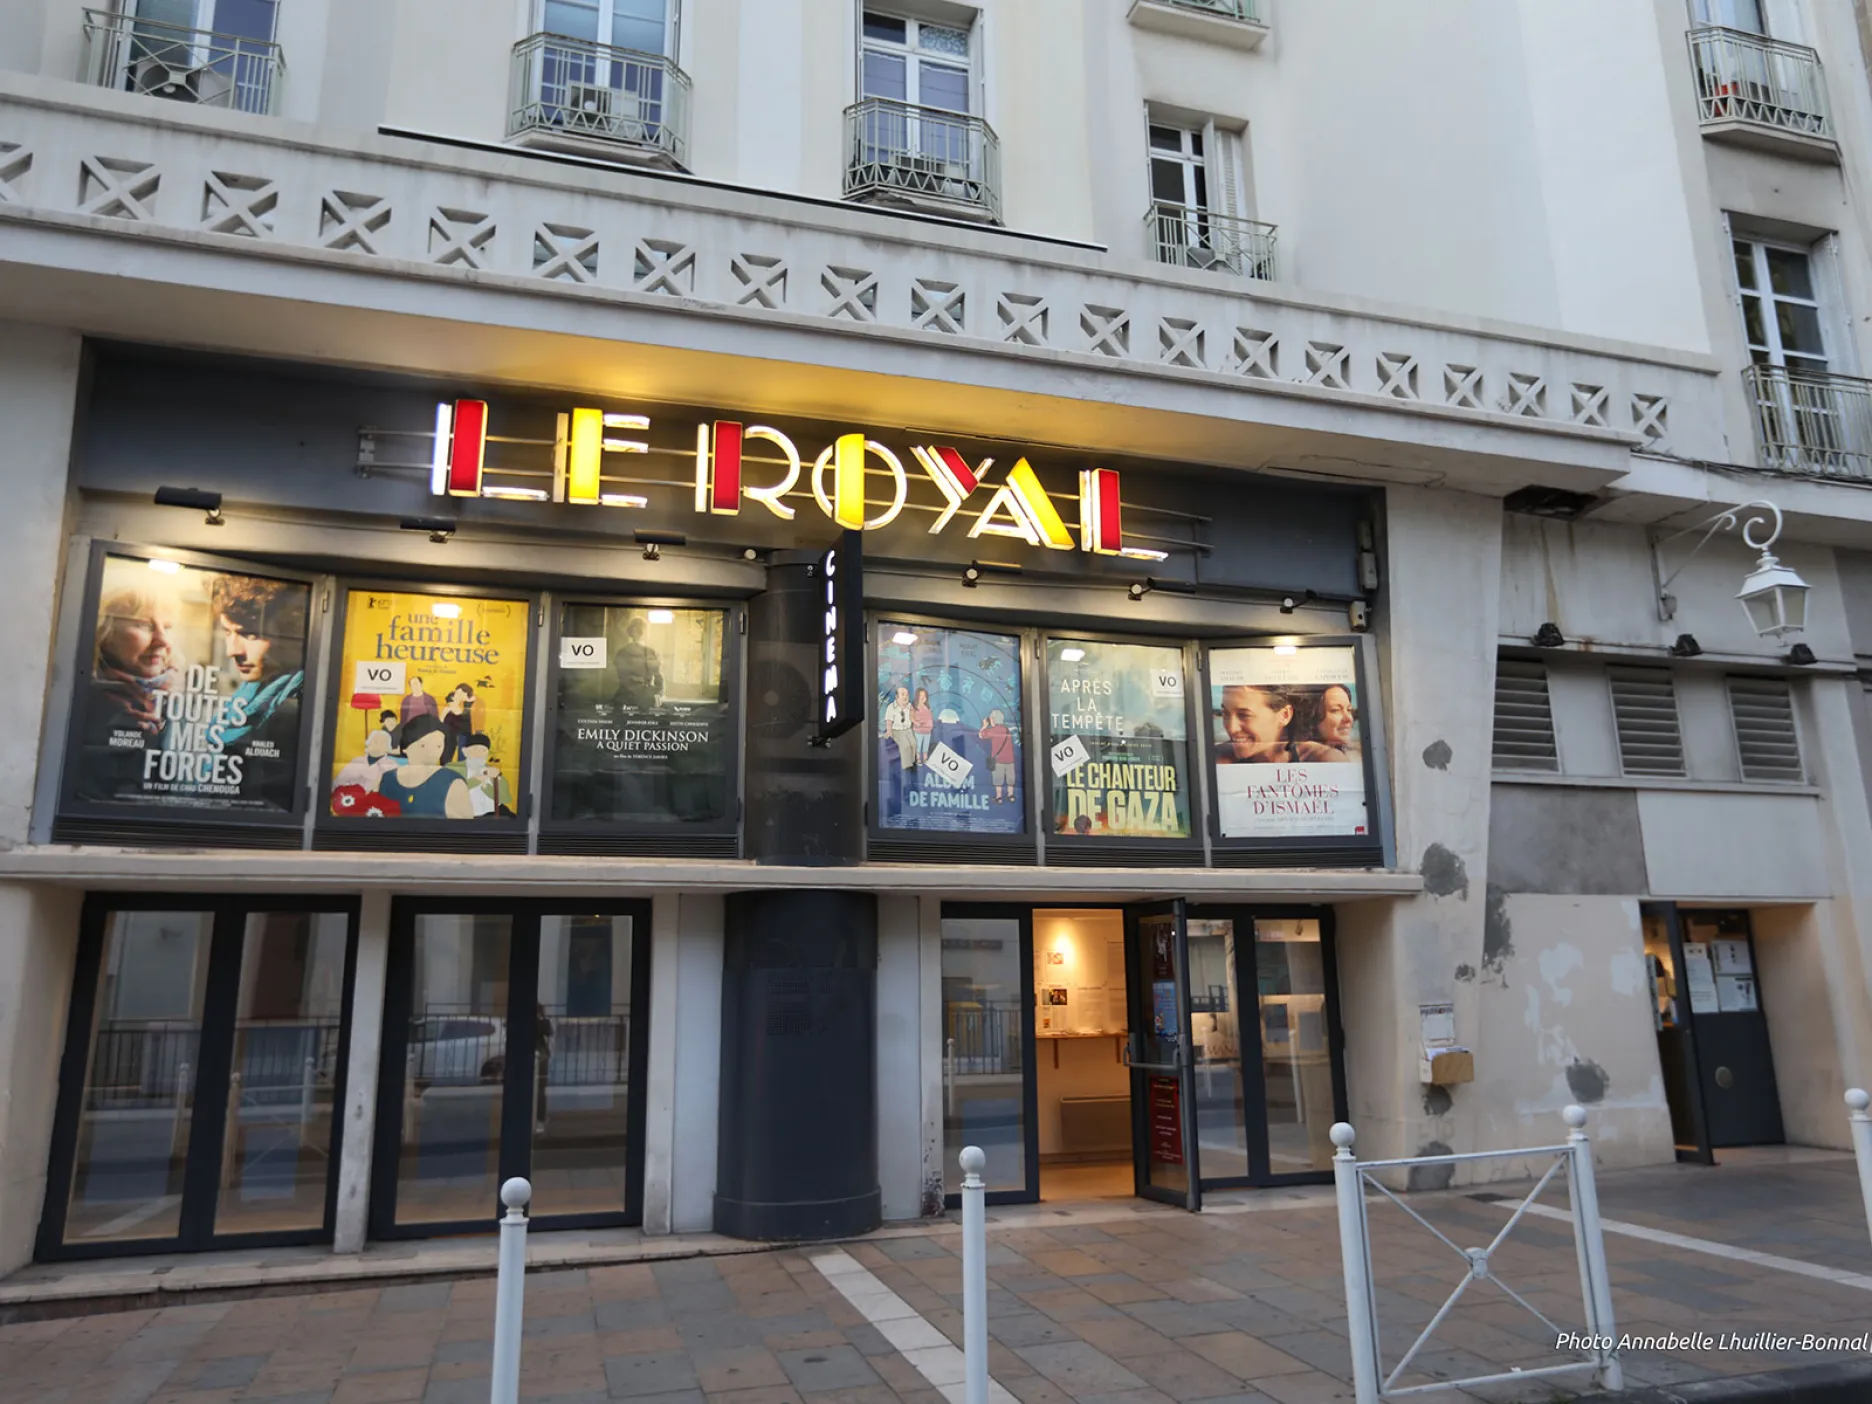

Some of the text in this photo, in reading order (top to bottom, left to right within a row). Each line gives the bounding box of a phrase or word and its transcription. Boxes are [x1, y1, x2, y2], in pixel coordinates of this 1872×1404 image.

[432, 399, 1169, 562] LE ROYAL
[389, 615, 491, 645] famille
[825, 550, 838, 724] CINEMA
[375, 633, 500, 665] heureuse
[571, 644, 595, 657] VO
[187, 664, 221, 694] DE
[367, 668, 392, 682] VO
[1158, 675, 1177, 688] VO
[152, 690, 248, 727] TOUTES
[1076, 697, 1097, 712] LA
[1051, 712, 1124, 731] TEMPÊTE
[108, 737, 146, 749] MOREAU
[169, 721, 226, 754] MES
[577, 727, 709, 743] EMILY DICKINSON
[596, 741, 689, 752] A QUIET PASSION
[1054, 745, 1074, 762] VO
[143, 749, 243, 785] FORCES
[941, 751, 959, 772] VO
[1066, 762, 1178, 792] LE CHANTEUR
[1276, 768, 1308, 783] LES
[909, 790, 928, 808] DE
[1067, 788, 1102, 830] DE
[1106, 789, 1179, 832] GAZA
